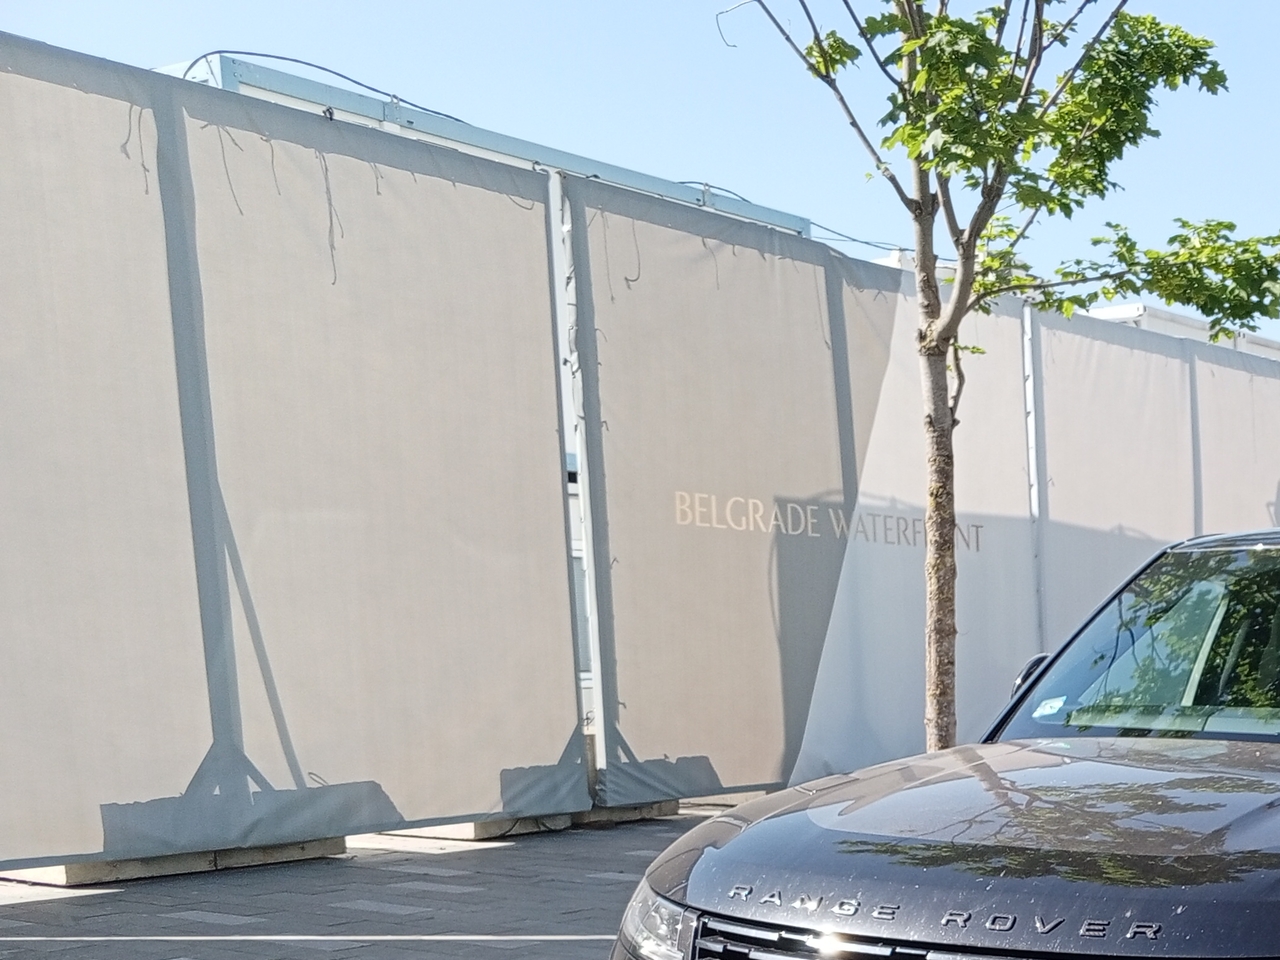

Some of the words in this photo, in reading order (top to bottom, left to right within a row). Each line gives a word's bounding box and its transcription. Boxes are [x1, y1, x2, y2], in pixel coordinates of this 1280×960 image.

[675, 491, 821, 537] BELGRADE
[828, 507, 984, 553] WATERFNT
[729, 885, 901, 920] RANGE
[941, 910, 1163, 940] ROVER
